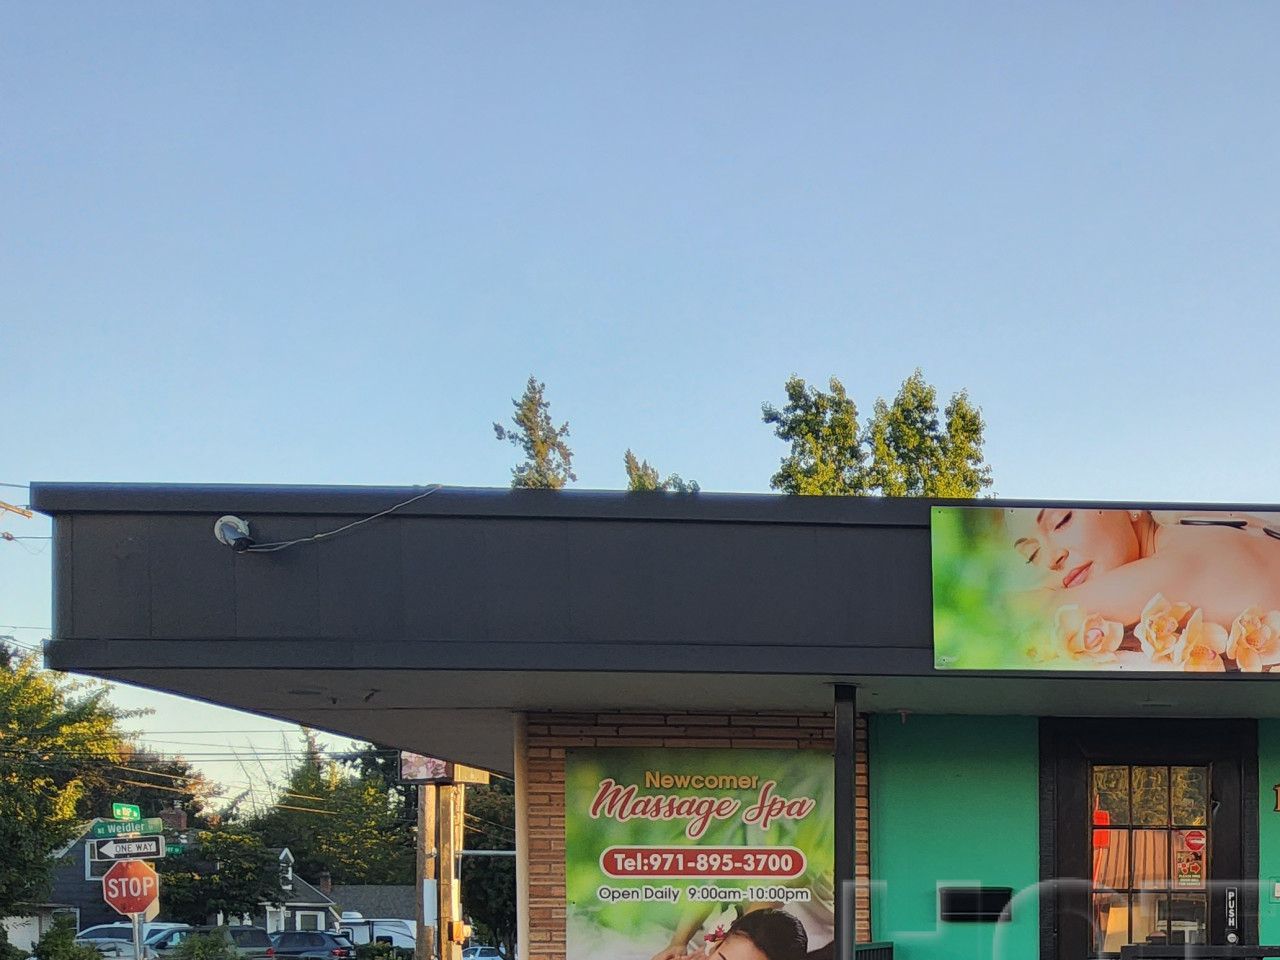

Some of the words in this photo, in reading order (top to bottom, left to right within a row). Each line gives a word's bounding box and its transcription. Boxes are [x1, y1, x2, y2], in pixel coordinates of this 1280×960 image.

[644, 771, 760, 789] Newcomer
[590, 779, 739, 838] Massage
[744, 781, 815, 828] Spa
[107, 823, 145, 834] Weidler
[115, 844, 132, 853] ONE
[135, 842, 153, 852] WAY
[613, 853, 794, 872] Tel:971-895-3700
[107, 876, 155, 898] STOP
[598, 887, 640, 901] Open
[644, 887, 680, 902] Daily
[688, 887, 809, 901] 9:00am-10:00pm
